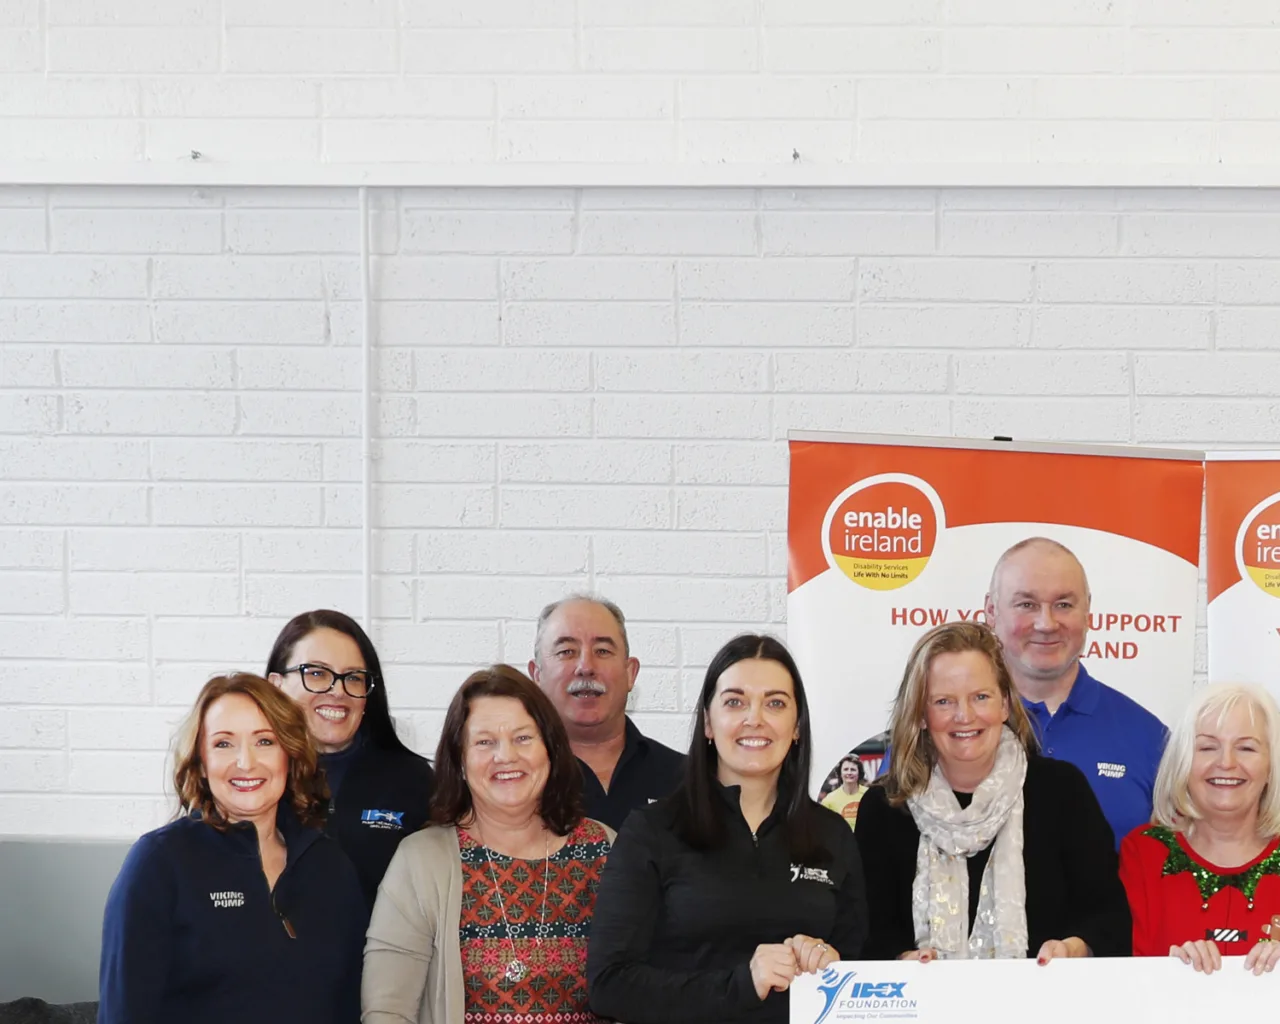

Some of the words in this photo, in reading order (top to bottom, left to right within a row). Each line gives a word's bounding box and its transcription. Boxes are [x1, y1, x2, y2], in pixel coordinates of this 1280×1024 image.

[844, 506, 922, 530] enable
[844, 529, 922, 553] ireland
[853, 563, 882, 571] Disability
[891, 607, 949, 626] HOW
[1087, 613, 1183, 633] UPPORT
[1097, 762, 1126, 772] VIKING
[1098, 769, 1125, 779] PUMP
[209, 891, 245, 900] VIKING
[214, 899, 245, 908] PUMP
[850, 982, 908, 998] IDEX
[838, 1000, 918, 1009] FOUNDATION
